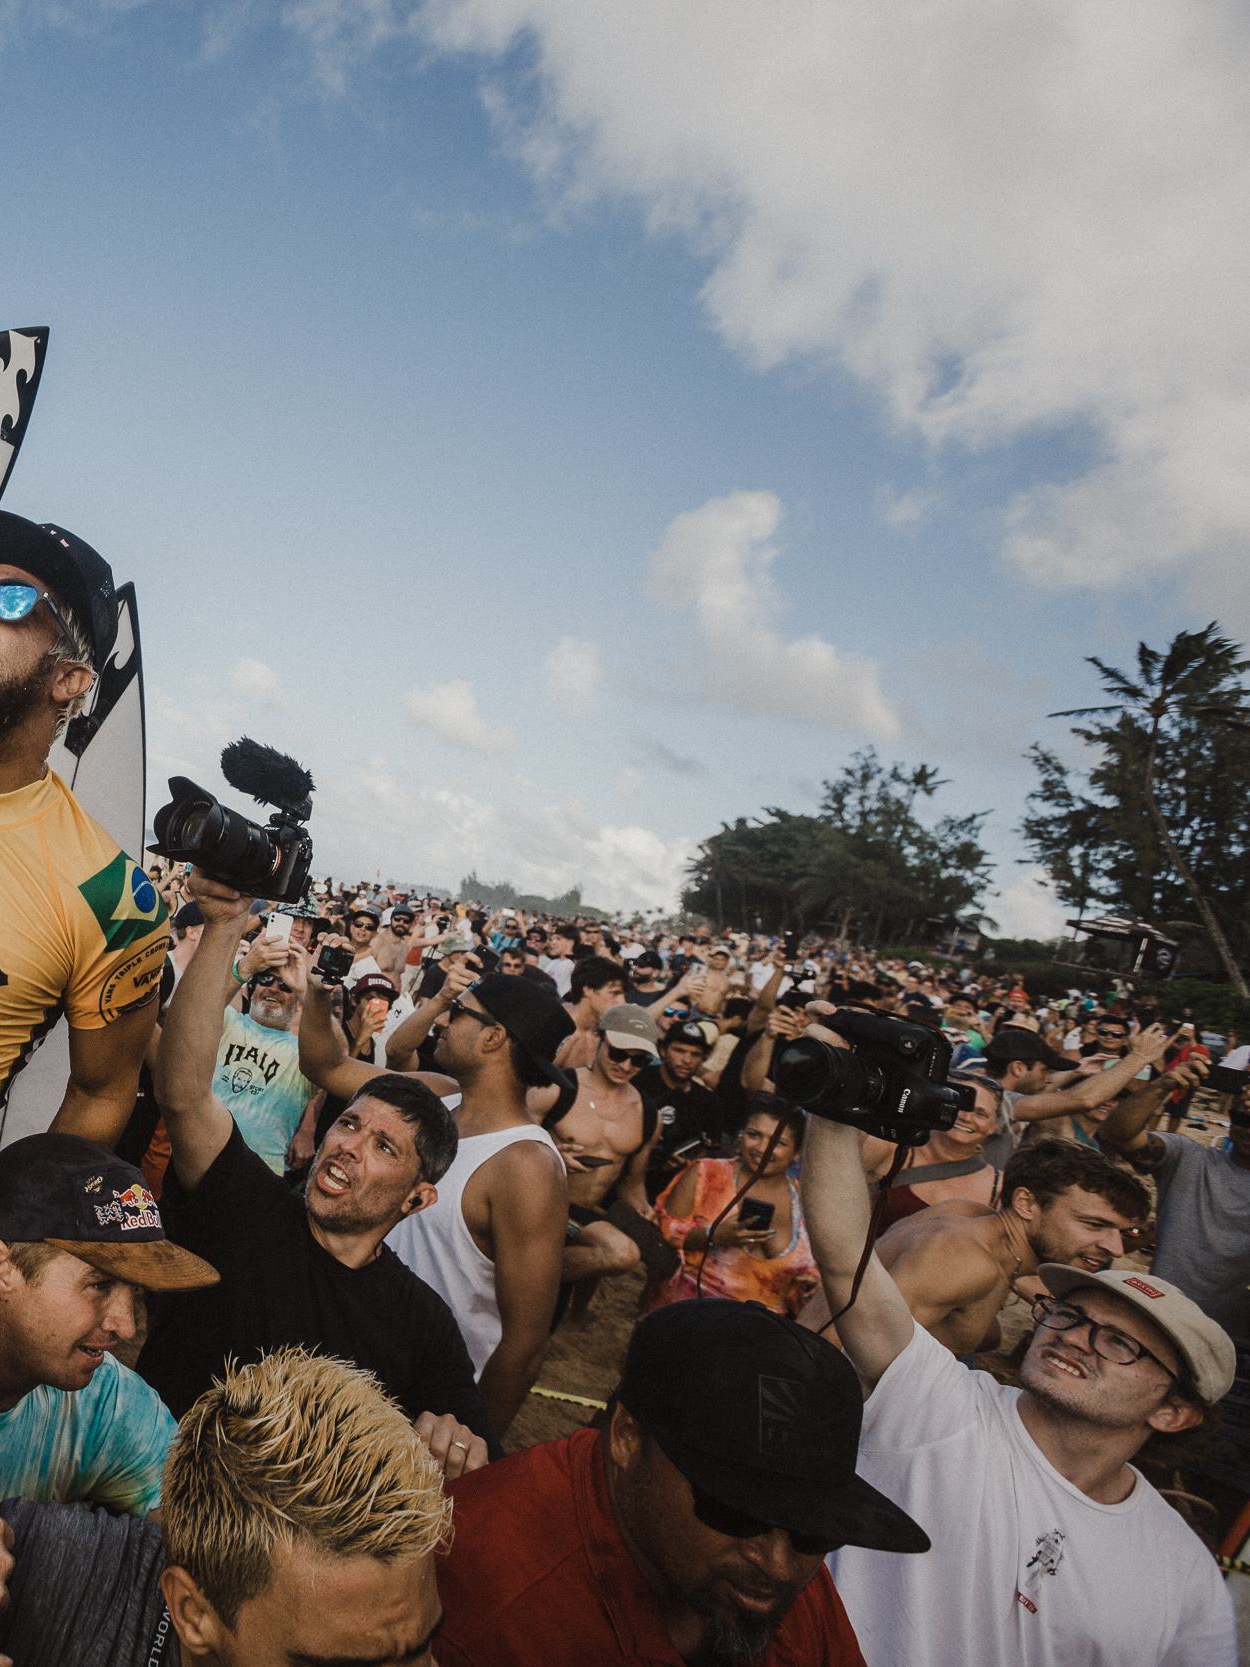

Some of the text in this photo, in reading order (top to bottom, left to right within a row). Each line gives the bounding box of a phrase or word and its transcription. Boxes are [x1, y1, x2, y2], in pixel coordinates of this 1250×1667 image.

[105, 983, 116, 1004] VANS
[114, 956, 142, 980] TRIPLE
[223, 1043, 281, 1085] ITALO
[897, 1088, 911, 1114] Canon
[122, 1210, 147, 1230] Red
